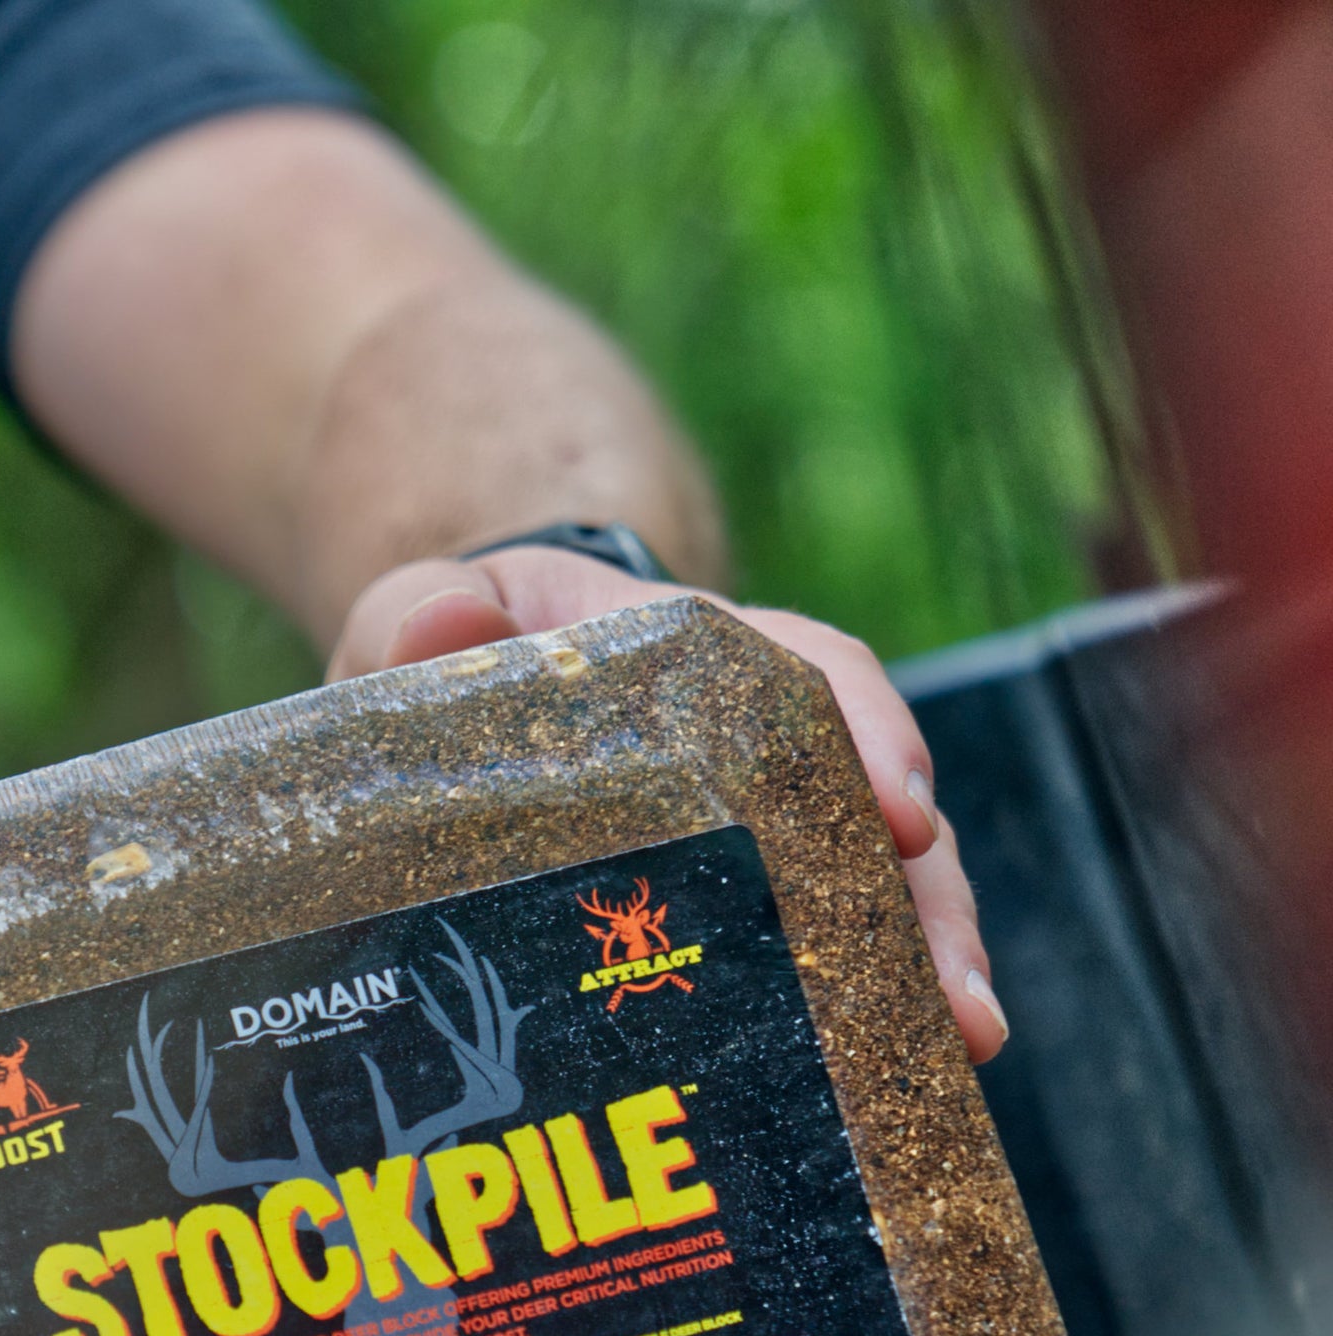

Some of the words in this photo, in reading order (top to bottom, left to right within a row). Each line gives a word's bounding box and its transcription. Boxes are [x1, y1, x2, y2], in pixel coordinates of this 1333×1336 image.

[579, 944, 704, 995] ATTRACT
[231, 968, 398, 1037] DOMAIN
[275, 1035, 299, 1049] This
[299, 1032, 311, 1044] is
[311, 1025, 337, 1041] your
[338, 1018, 367, 1034] land.
[381, 1307, 441, 1333] BLOCK
[441, 1283, 530, 1317] OFFERING
[532, 1262, 610, 1293] PREMIUM
[612, 1231, 725, 1271] INGREDIENTS
[460, 1310, 509, 1335] YOUR
[513, 1297, 558, 1320] DEER
[560, 1276, 637, 1308] CRITICAL
[640, 1251, 733, 1286] NUTRITION
[702, 1311, 742, 1330] BLOCK
